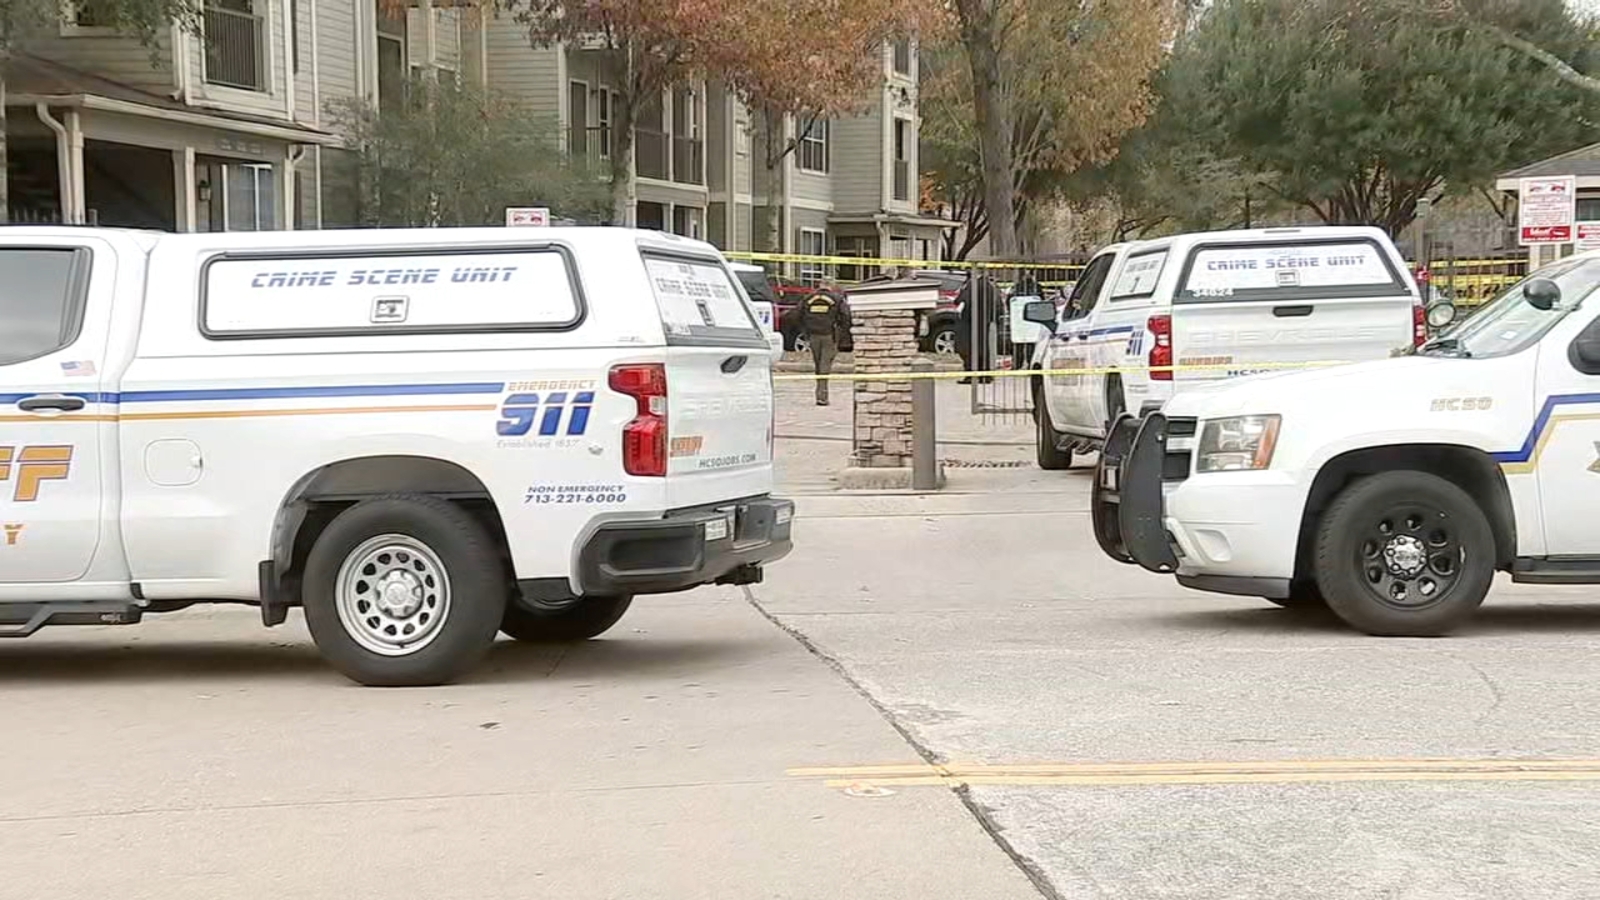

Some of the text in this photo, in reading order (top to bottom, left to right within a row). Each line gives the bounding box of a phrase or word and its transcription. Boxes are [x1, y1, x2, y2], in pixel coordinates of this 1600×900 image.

[1206, 255, 1366, 271] CRIME SCENE UNIT
[251, 267, 518, 288] CRIME SCENE UNIT
[508, 380, 597, 392] EMERGENCY
[1430, 396, 1493, 412] HCSO
[496, 391, 596, 436] 911
[0, 445, 74, 502] F
[527, 484, 625, 494] NON EMERGENCY
[524, 493, 627, 504] 713-221-6000
